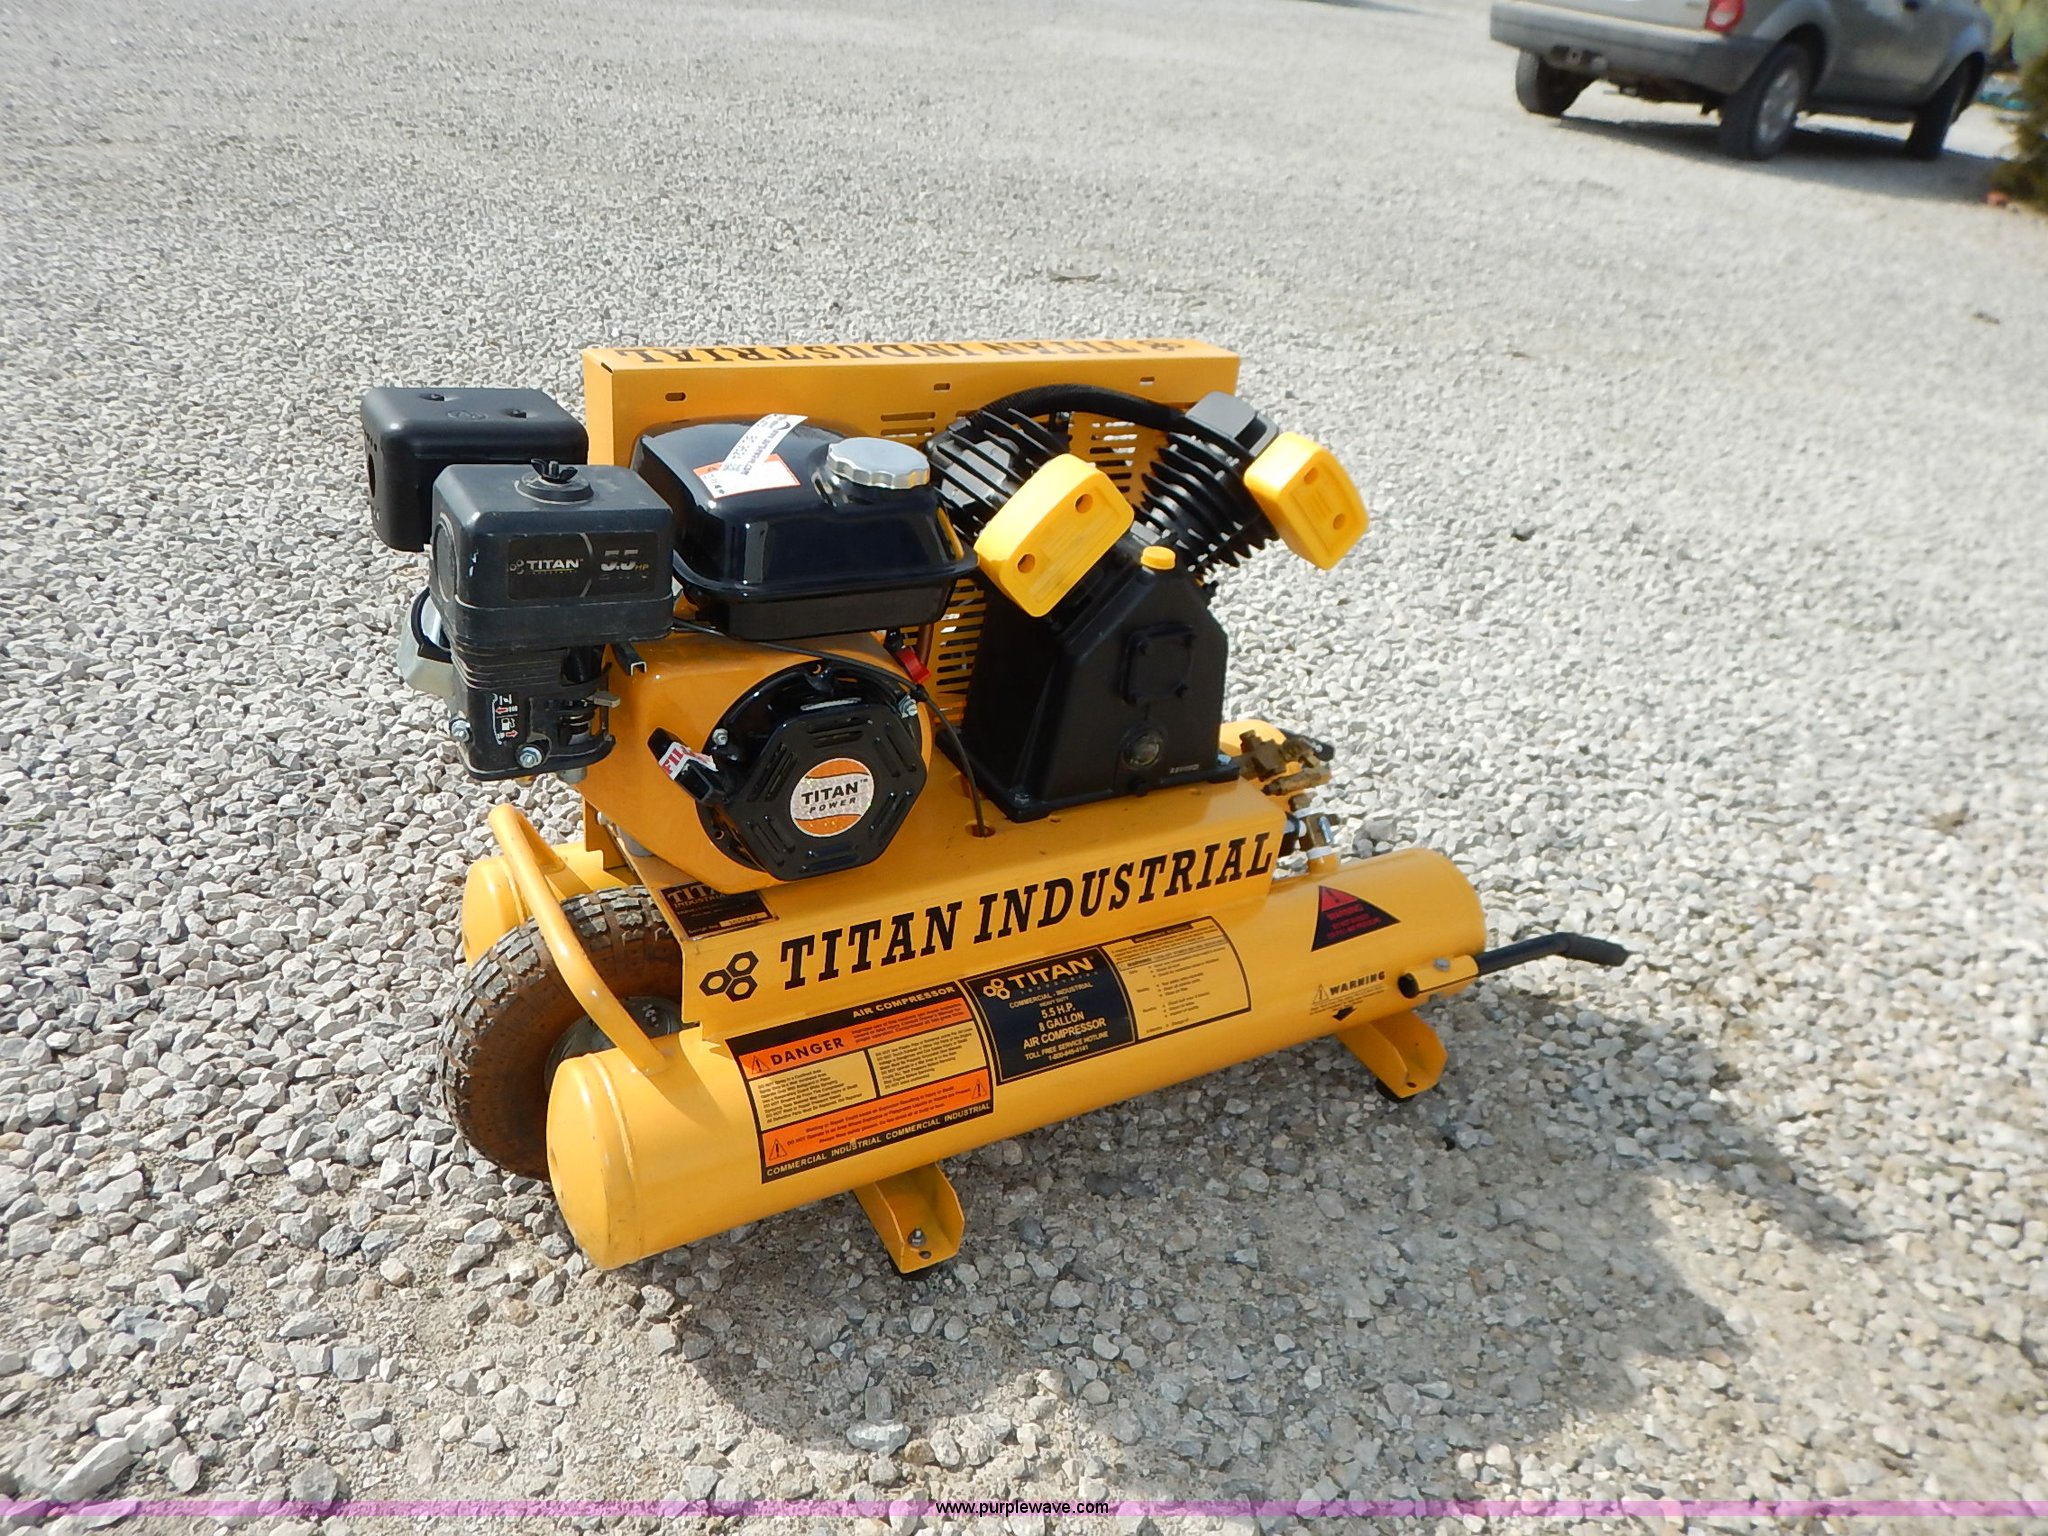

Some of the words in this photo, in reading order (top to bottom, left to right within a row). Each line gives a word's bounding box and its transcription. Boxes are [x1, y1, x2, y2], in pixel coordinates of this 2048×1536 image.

[526, 558, 580, 570] TITAN
[809, 797, 857, 814] POWER
[780, 901, 962, 990] TITAN
[972, 831, 1274, 944] INDUSTRIAL
[1008, 957, 1095, 989] TITAN
[1329, 971, 1386, 996] WARNING
[852, 1005, 874, 1019] AIR
[875, 986, 956, 1013] COMPRESSOR
[1009, 992, 1053, 1008] COMMERCIAL
[1056, 982, 1094, 996] INDUSTRIAL
[1039, 1022, 1045, 1032] 8
[1046, 1011, 1085, 1030] GALLON
[1041, 1007, 1056, 1019] 5.5
[1057, 1002, 1076, 1015] H.P.
[1023, 1037, 1041, 1050] AIR
[1041, 1018, 1107, 1044] COMPRESSOR
[771, 1036, 845, 1066] DANGER
[1025, 1050, 1041, 1061] TOLL
[1041, 1046, 1057, 1057] FREE
[1057, 1040, 1083, 1052] SERVICE
[766, 1153, 828, 1177] COMMERCIAL
[831, 1136, 882, 1157] INDUSTRIAL
[885, 1118, 941, 1140] COMMERCIAL
[944, 1102, 992, 1122] INDUSTRIAL
